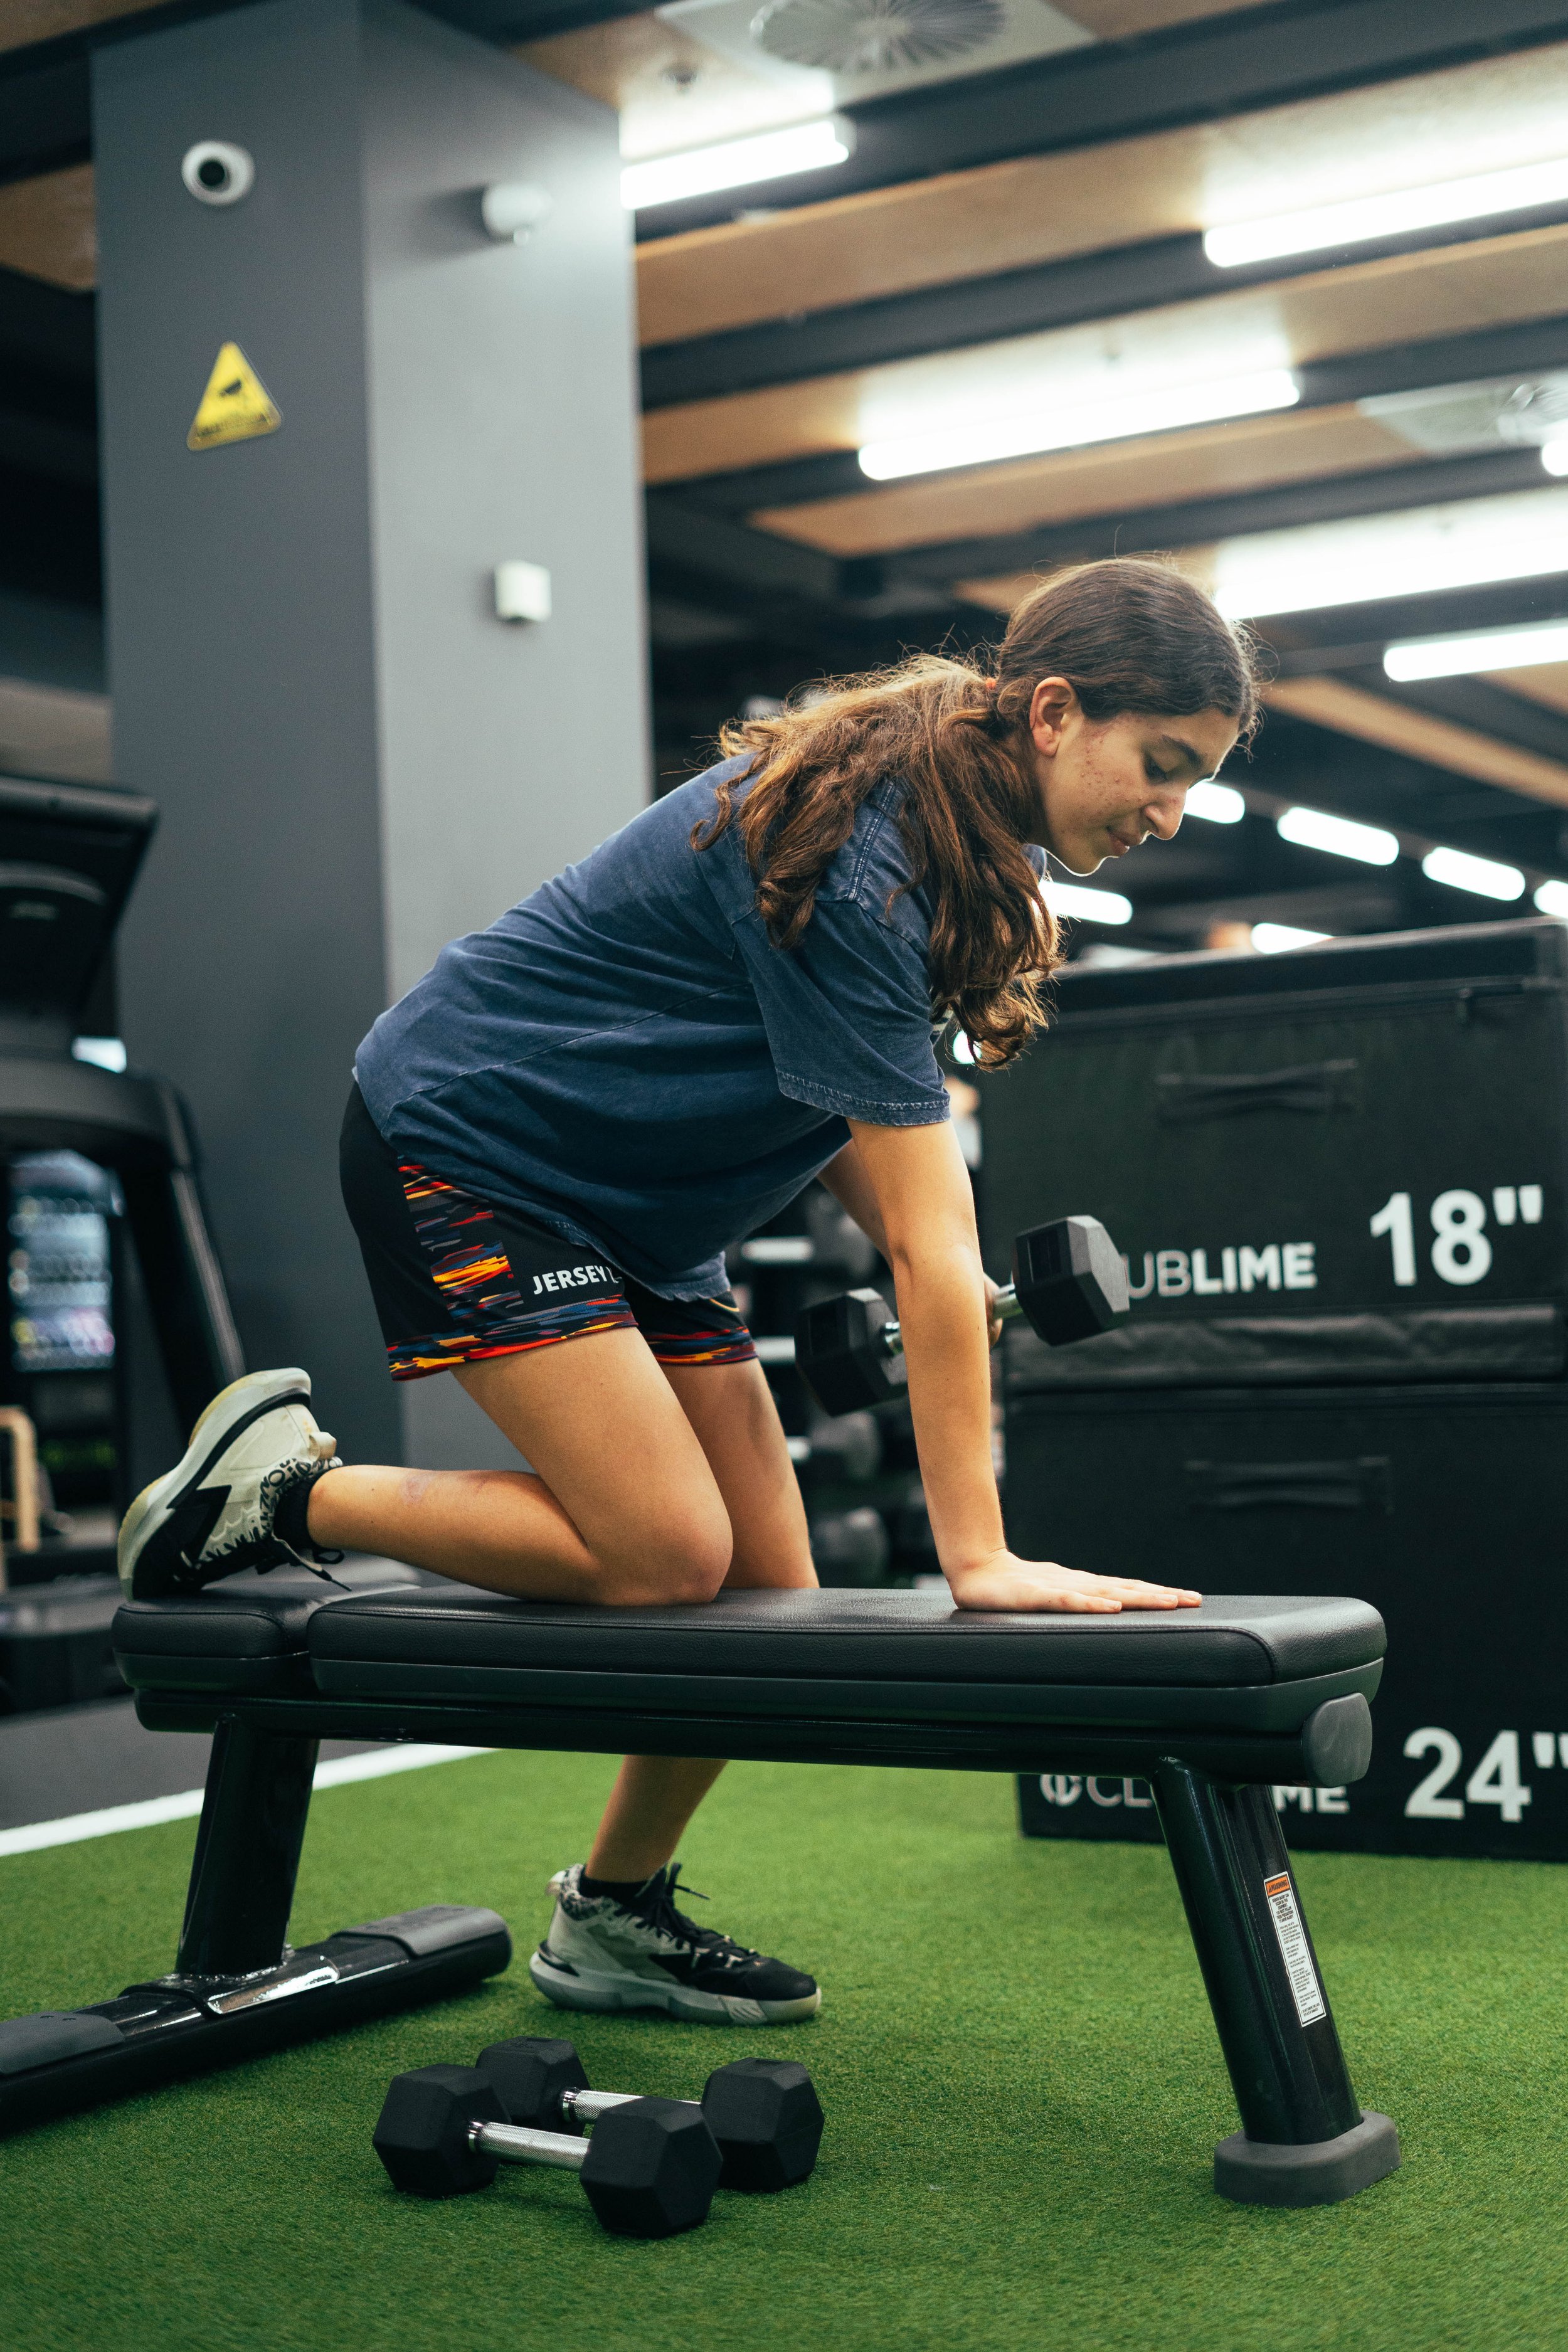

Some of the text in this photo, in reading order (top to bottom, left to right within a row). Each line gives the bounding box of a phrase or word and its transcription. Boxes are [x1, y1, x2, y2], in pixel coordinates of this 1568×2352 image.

[532, 1264, 607, 1295] JERSEY
[1370, 1184, 1544, 1286] 18"
[1403, 1726, 1568, 1823] 24"
